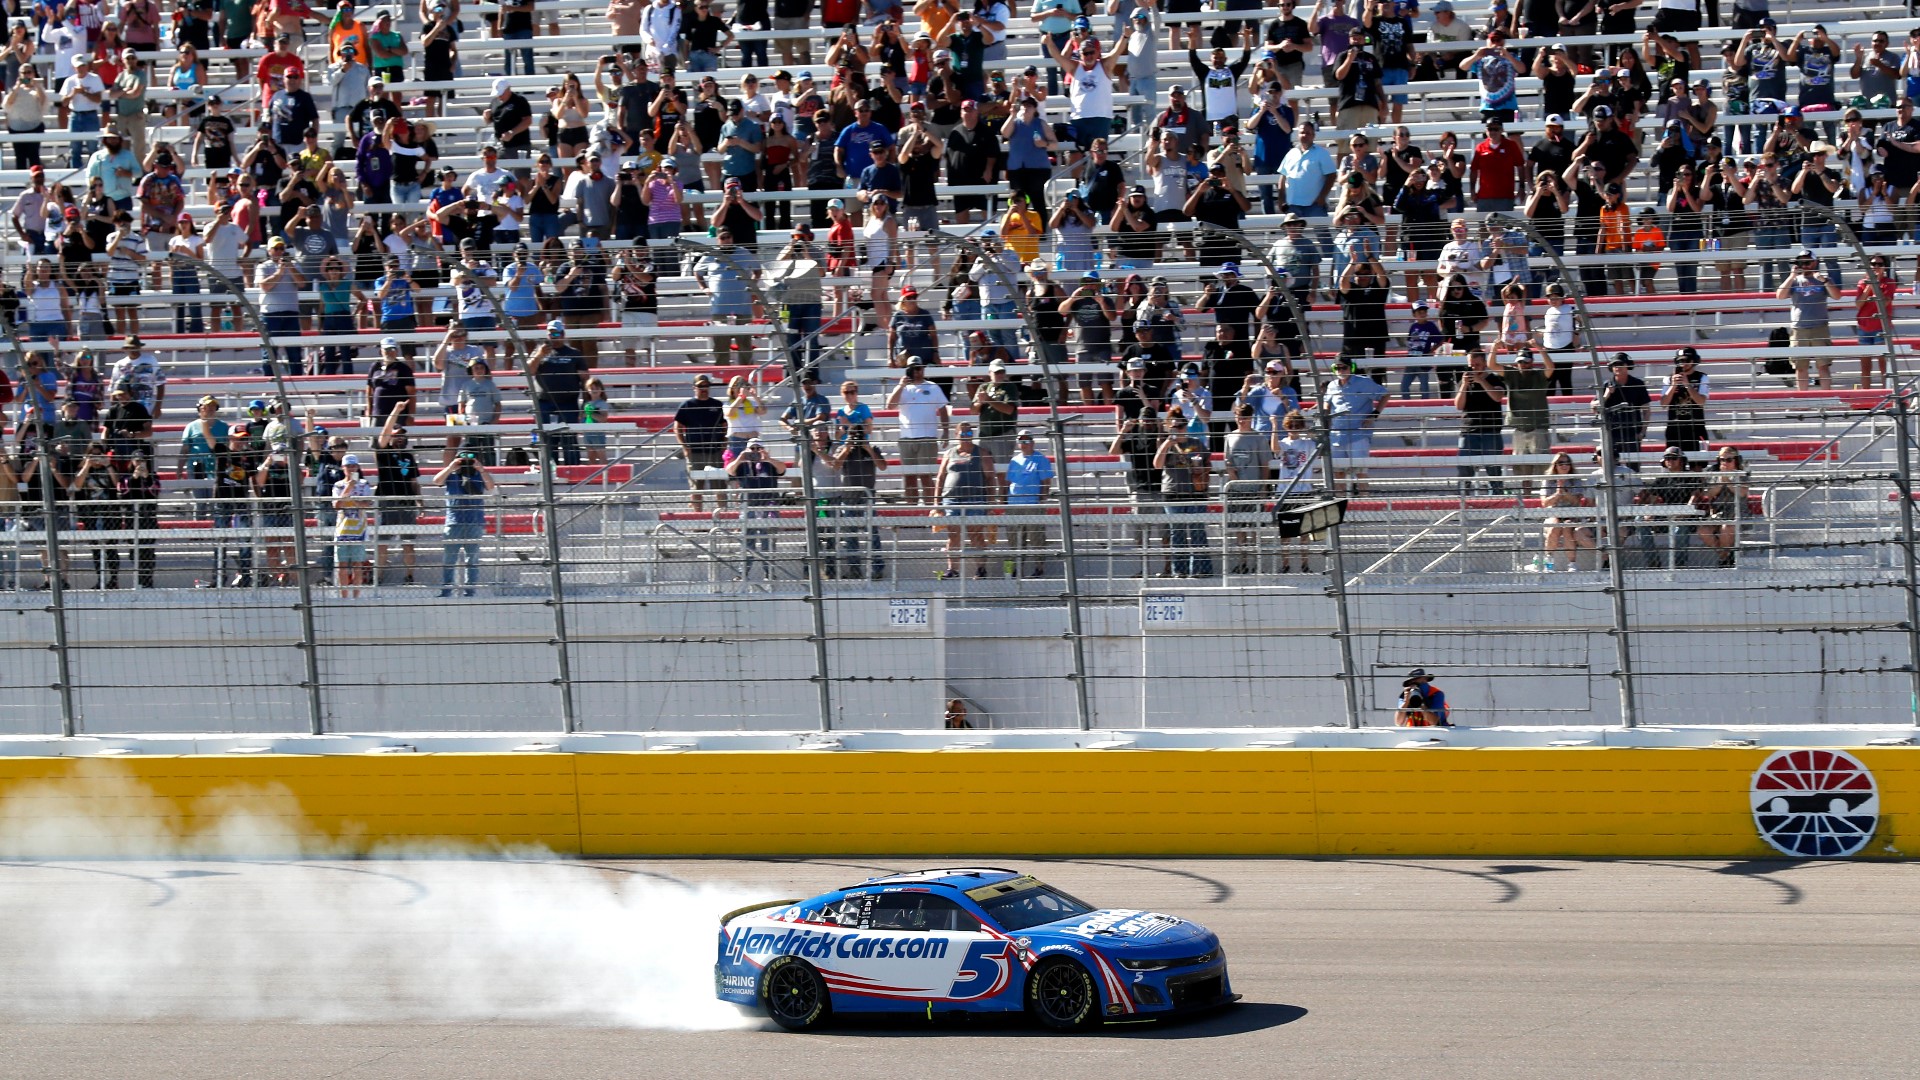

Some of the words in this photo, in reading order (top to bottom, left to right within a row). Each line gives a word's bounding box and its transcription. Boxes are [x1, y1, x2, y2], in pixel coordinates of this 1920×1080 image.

[897, 608, 926, 624] 2C-2E
[1146, 605, 1176, 621] 2E-2G
[725, 926, 950, 965] HendrickCars.com
[945, 939, 1011, 1000] 5
[1133, 971, 1145, 983] 5
[722, 975, 755, 988] HIRING
